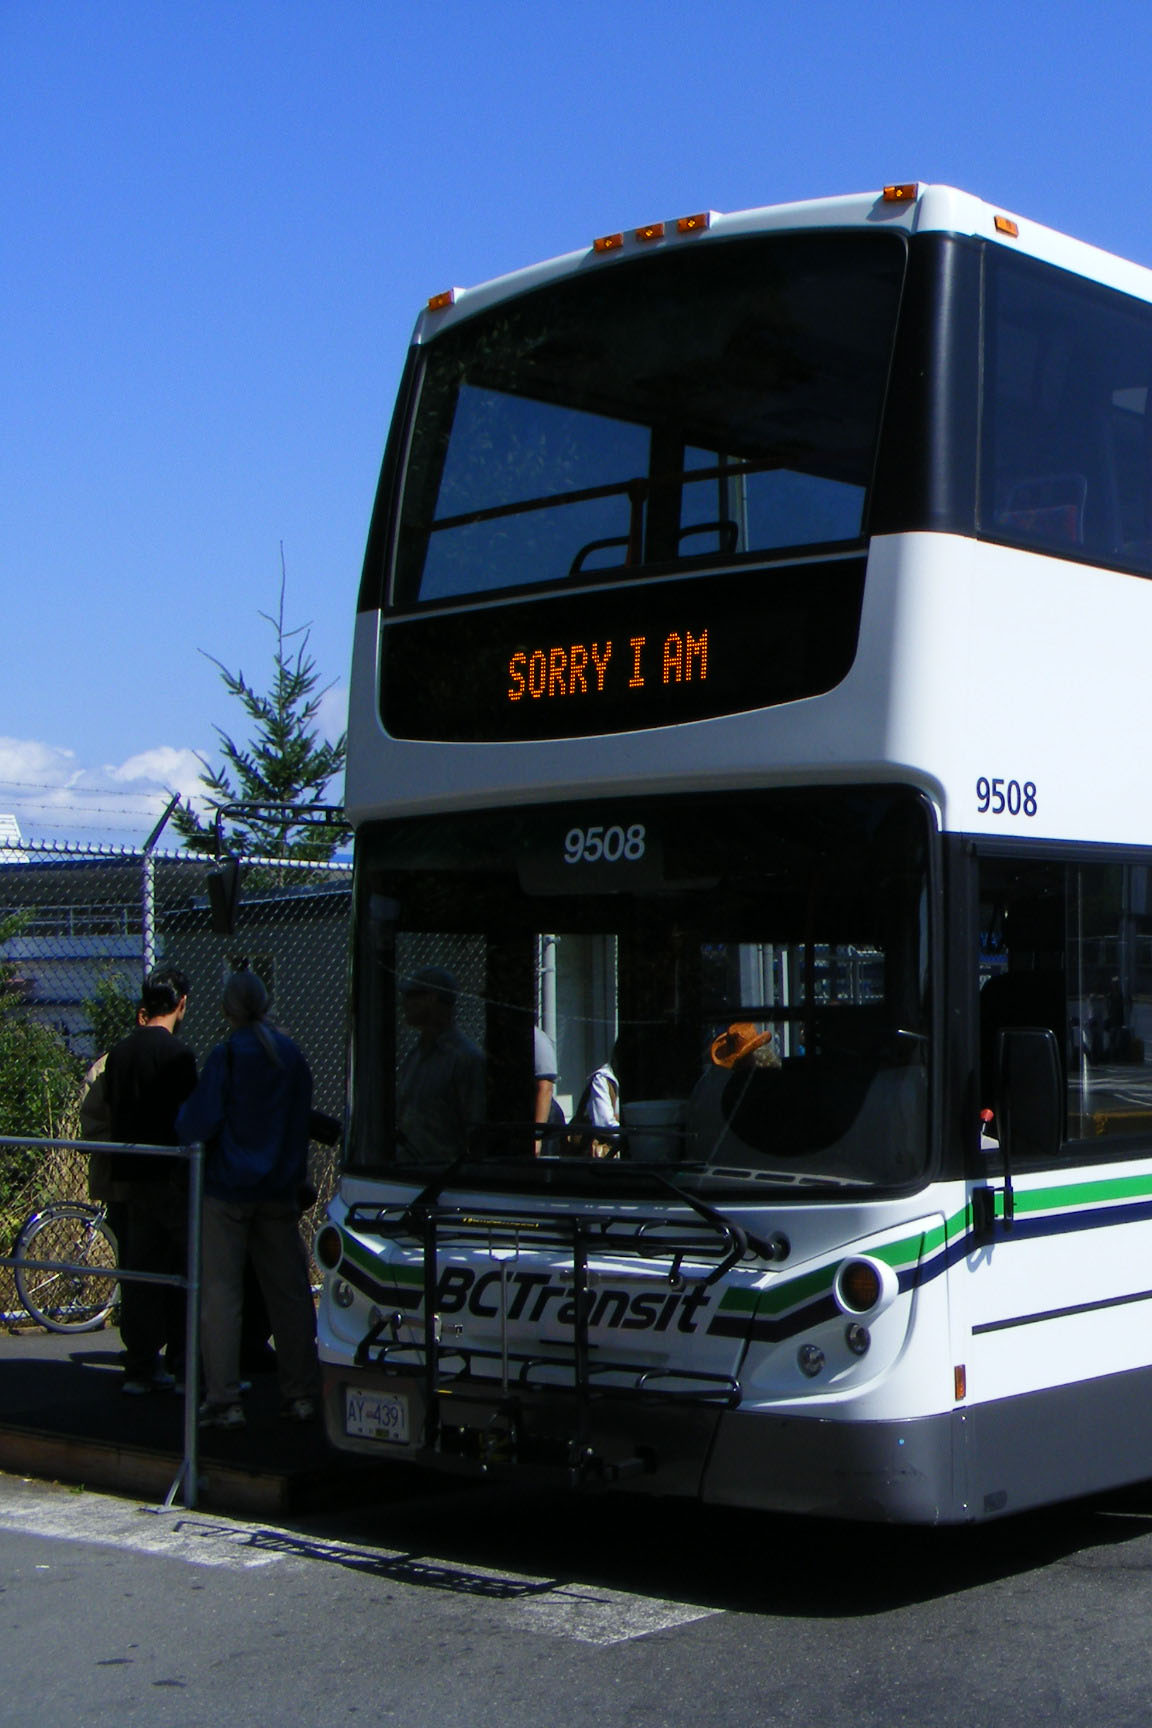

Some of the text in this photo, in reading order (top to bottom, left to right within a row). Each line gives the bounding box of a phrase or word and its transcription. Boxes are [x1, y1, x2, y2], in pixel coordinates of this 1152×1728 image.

[508, 629, 708, 700] SORRY I AM
[977, 777, 1038, 818] 9508
[564, 824, 646, 865] 9508
[436, 1266, 711, 1334] BCTransit
[348, 1400, 365, 1422] AY
